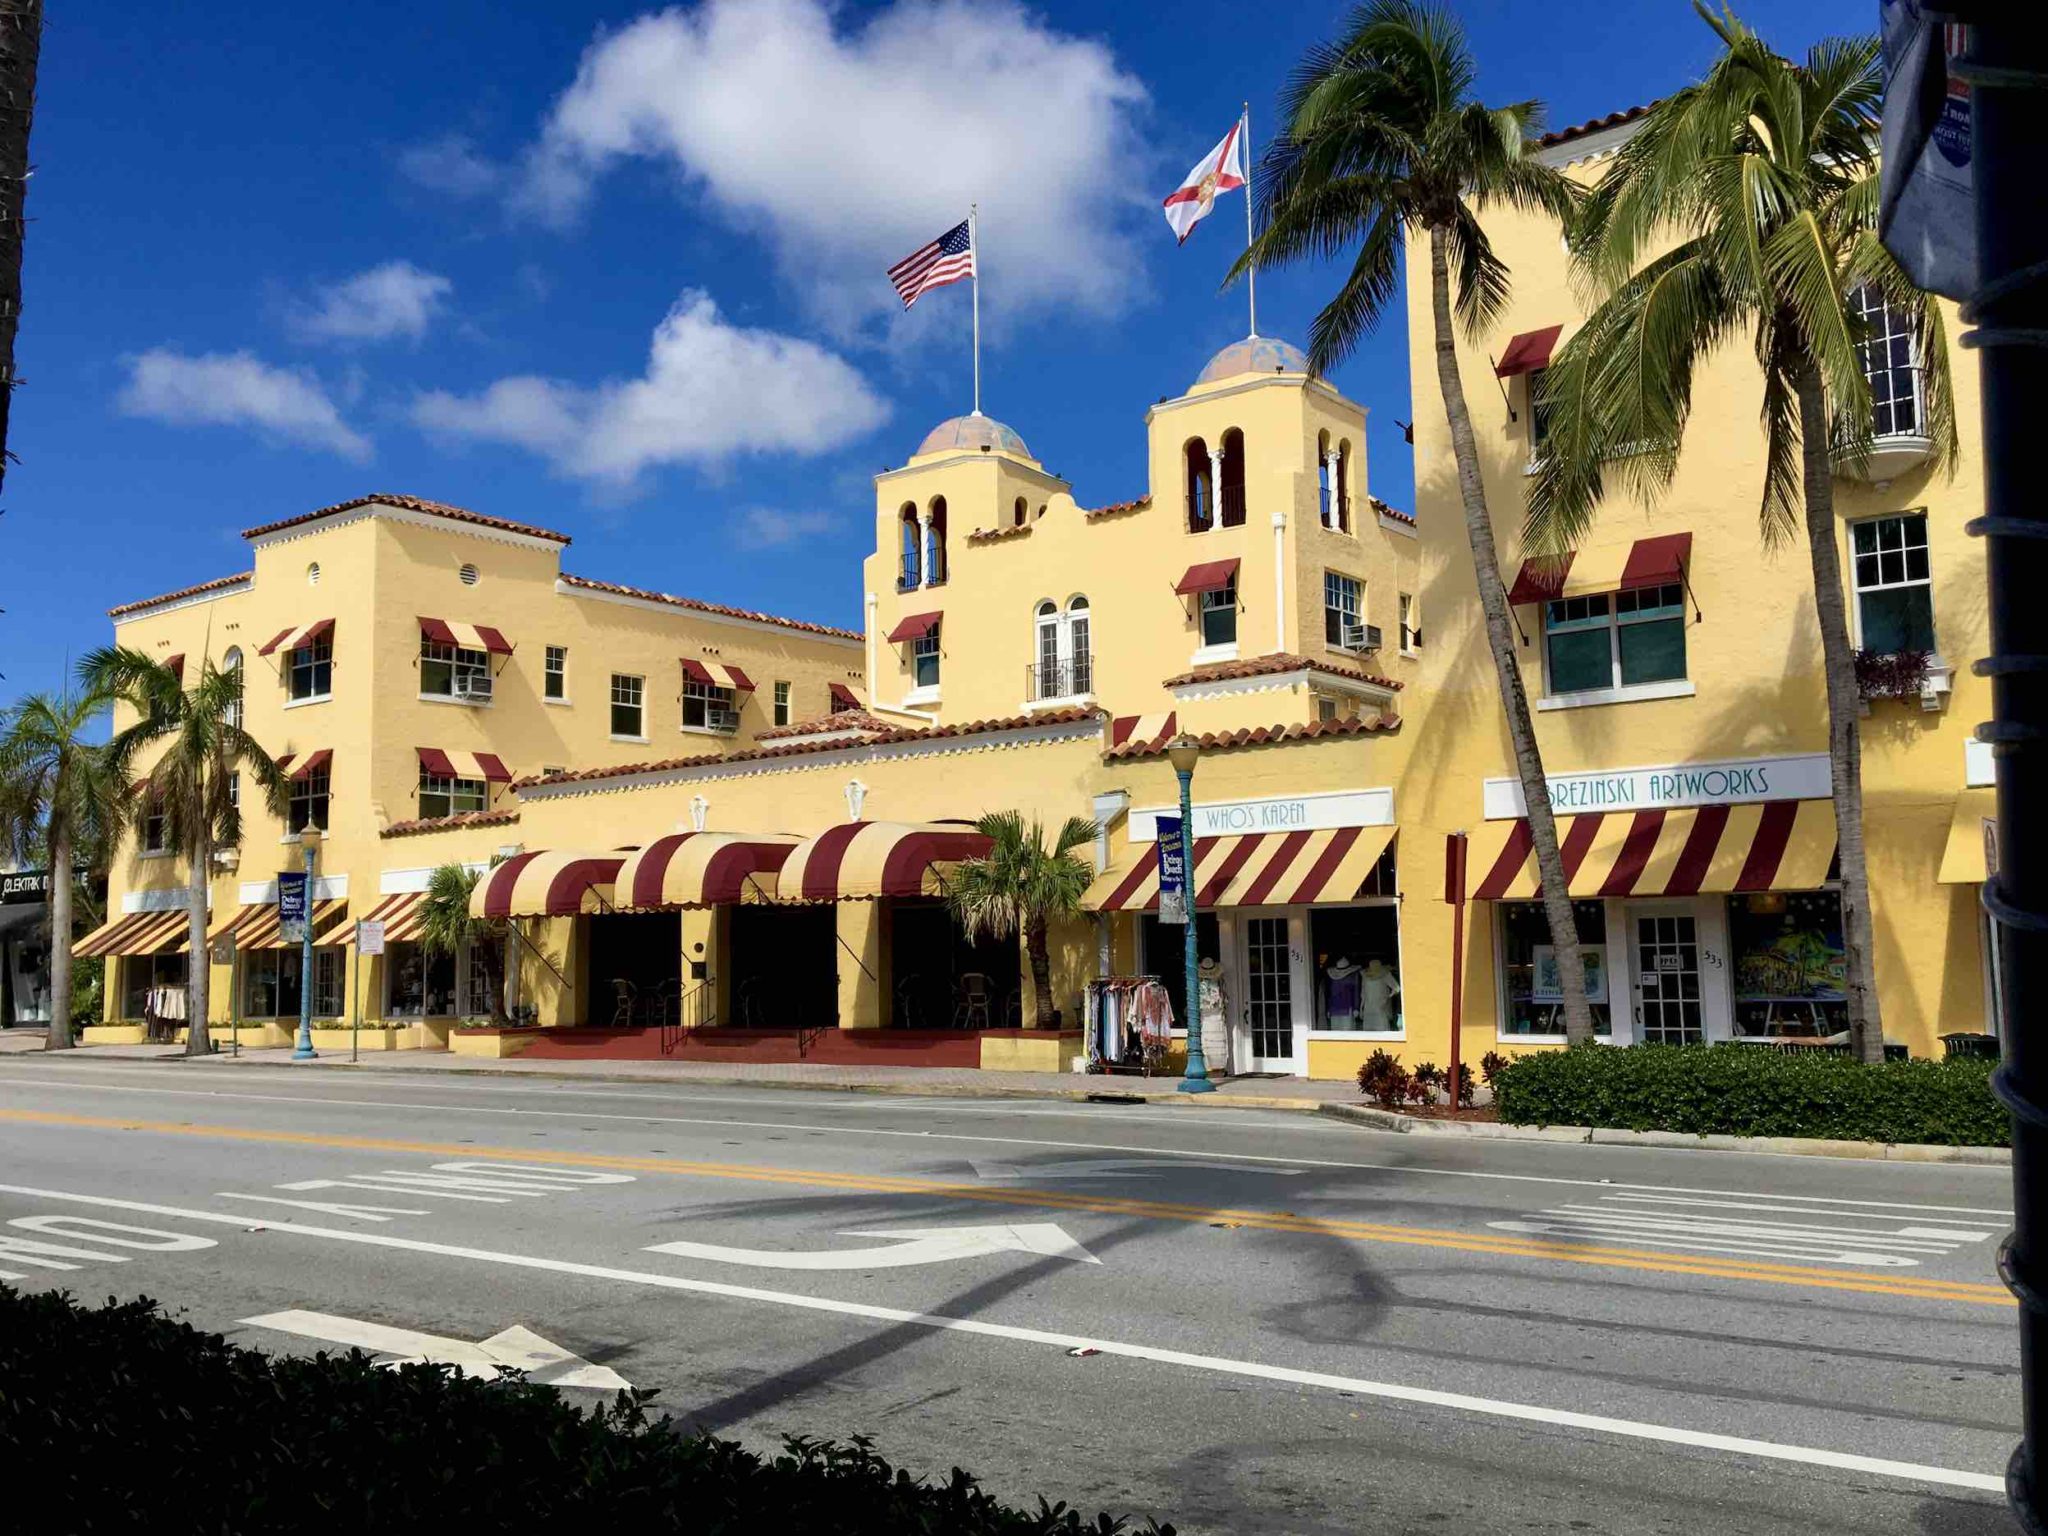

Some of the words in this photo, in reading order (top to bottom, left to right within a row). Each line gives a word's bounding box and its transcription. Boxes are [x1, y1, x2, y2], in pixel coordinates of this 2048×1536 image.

[1546, 777, 1635, 807] BREZINSKI
[1650, 767, 1769, 801] ARTWORKS
[1206, 805, 1255, 829] WHO'S
[1262, 803, 1305, 826] KAREN
[1163, 854, 1183, 866] Delray
[1164, 863, 1183, 875] Beach
[1704, 950, 1723, 969] 533
